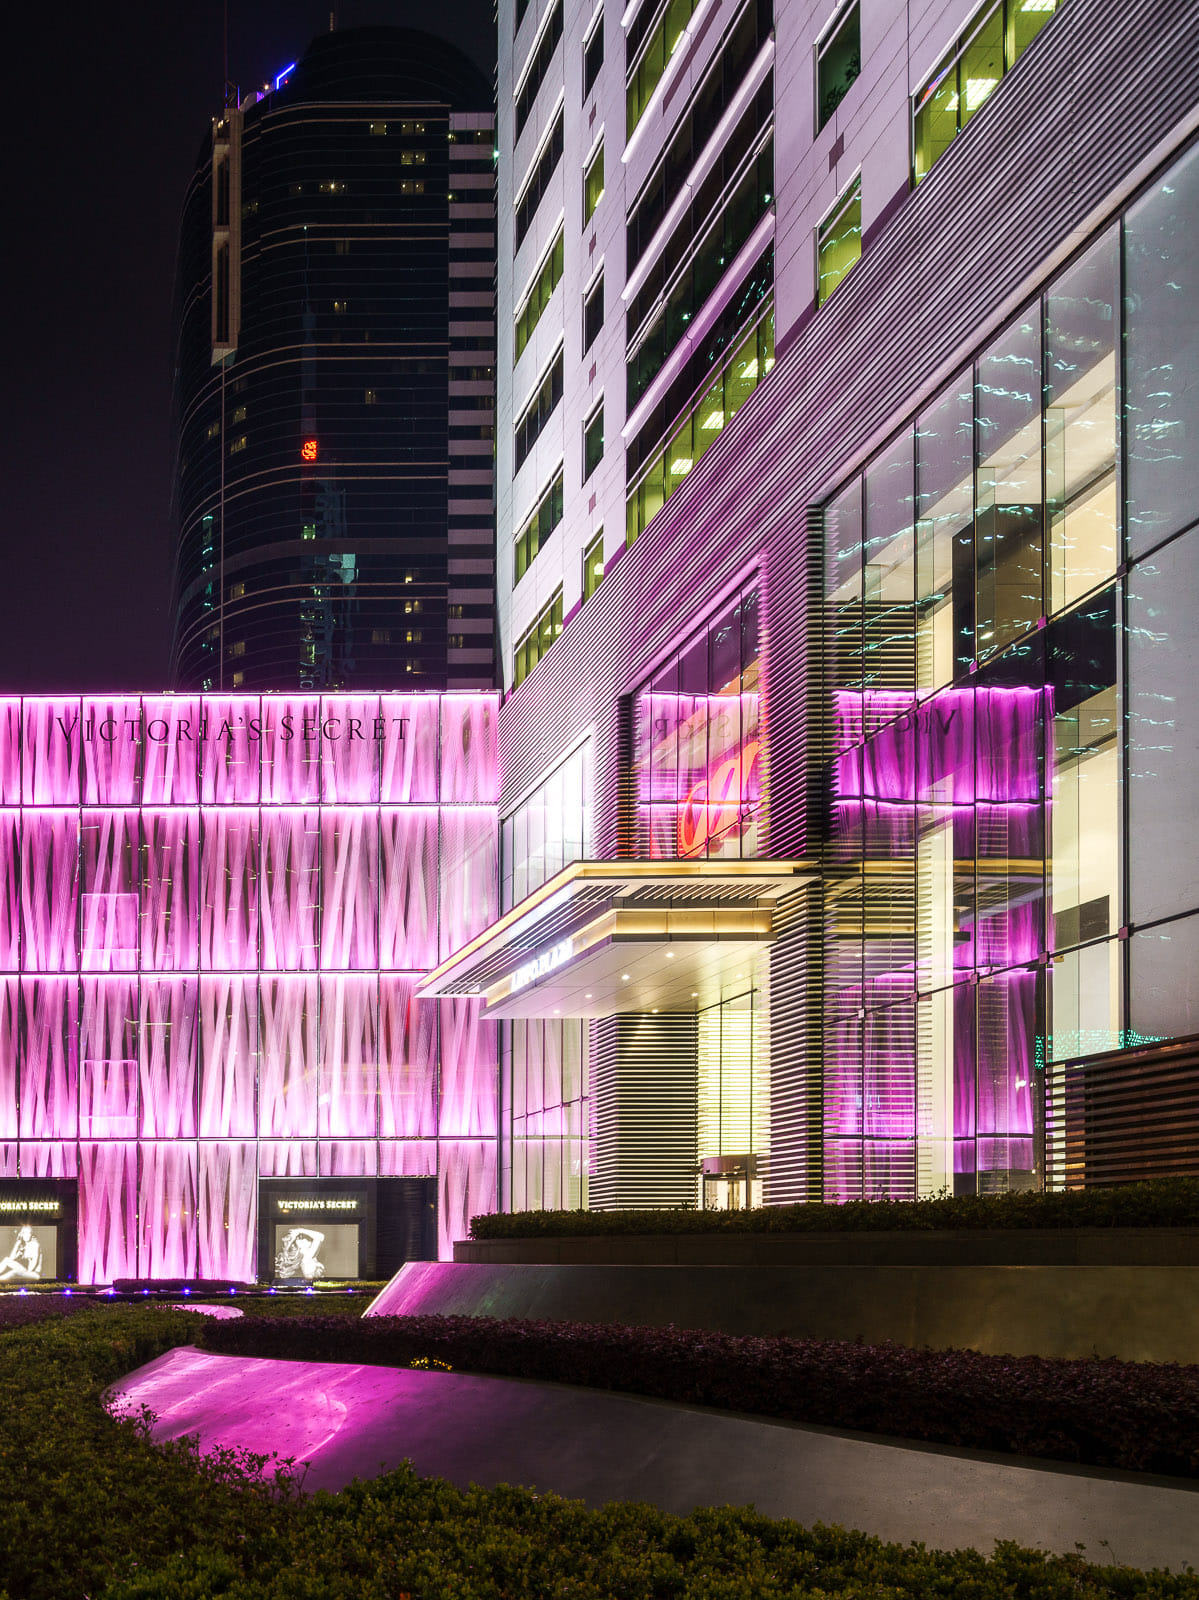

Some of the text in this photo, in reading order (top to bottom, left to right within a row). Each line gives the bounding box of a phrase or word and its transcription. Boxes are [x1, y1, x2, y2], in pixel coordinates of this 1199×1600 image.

[56, 715, 411, 744] VICTORIA'S SECRET
[29, 1201, 59, 1210] SECRET
[277, 1200, 357, 1209] VICTORIA'S SECRET
